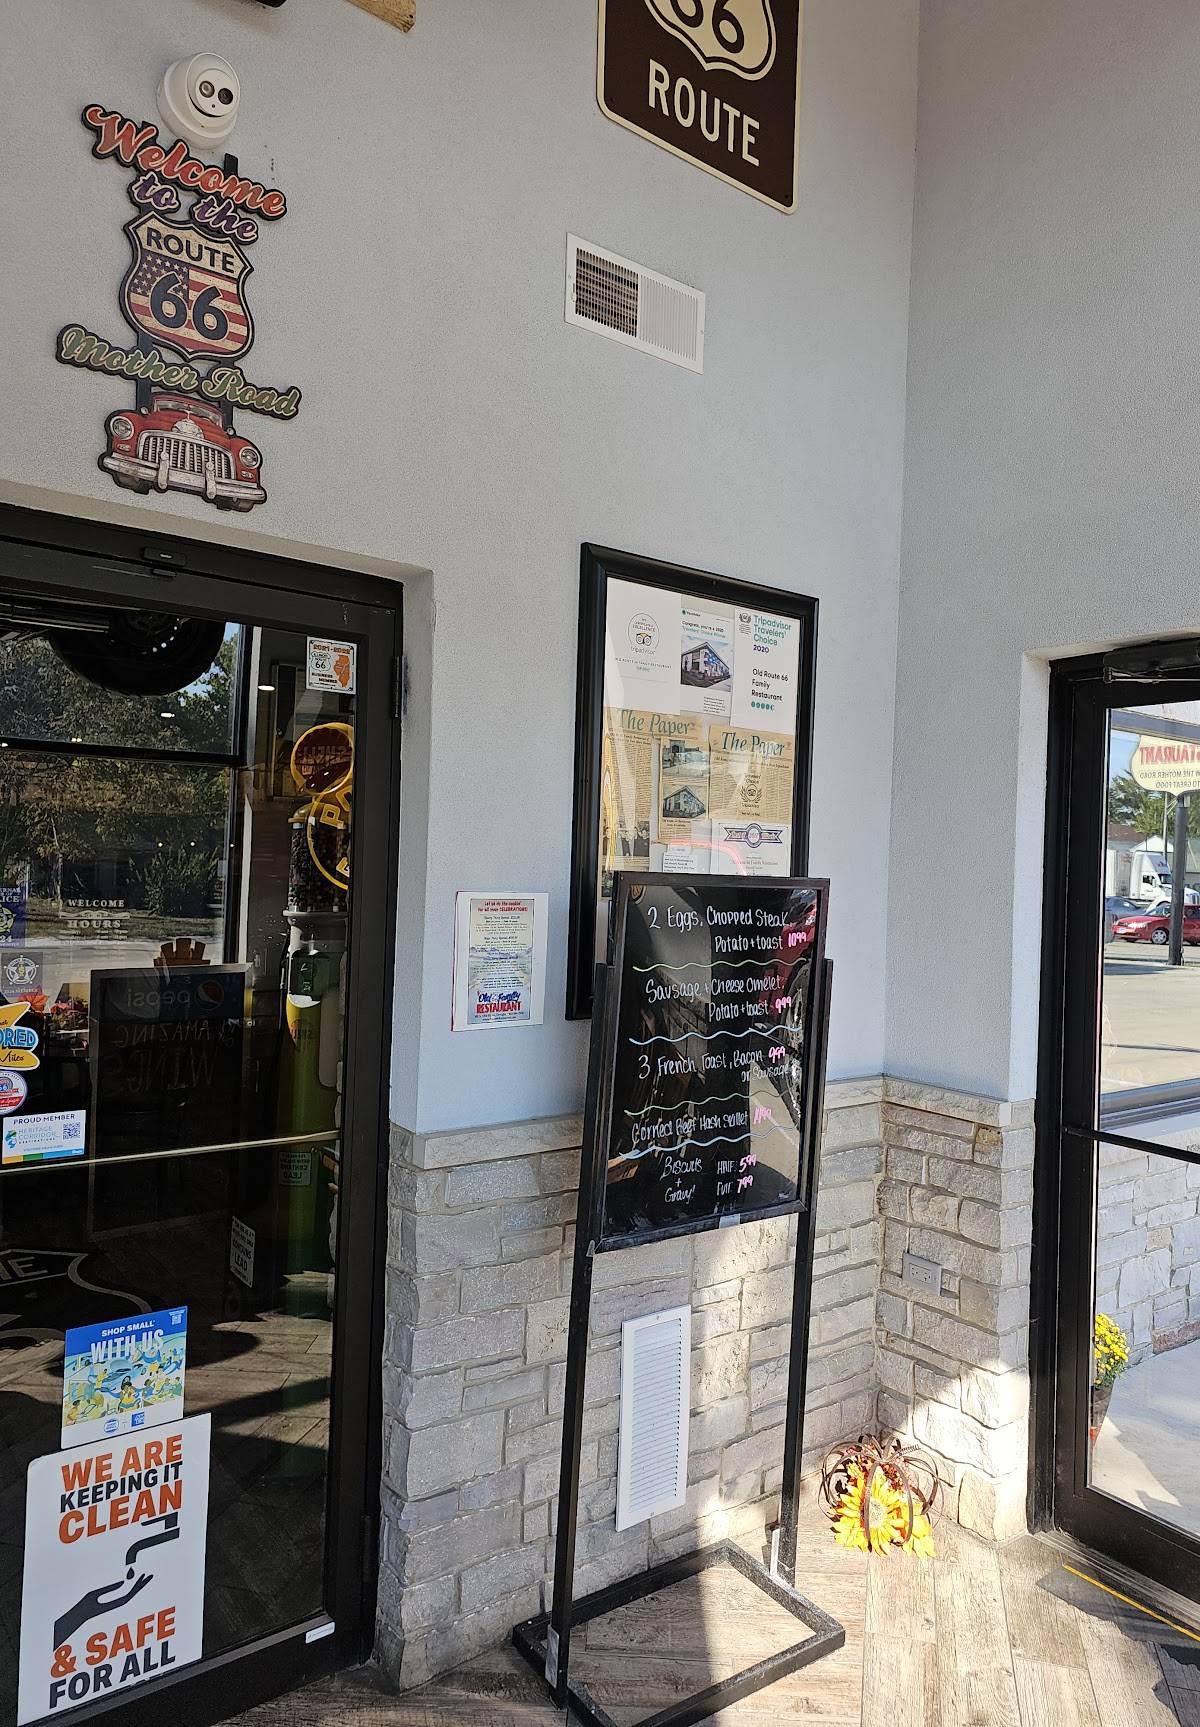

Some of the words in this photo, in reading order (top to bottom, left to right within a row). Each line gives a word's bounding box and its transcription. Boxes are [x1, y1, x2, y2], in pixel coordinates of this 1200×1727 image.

[648, 58, 760, 167] ROUTE
[86, 106, 285, 216] Welcome
[131, 172, 179, 210] to
[193, 195, 258, 242] the
[146, 226, 235, 274] ROUTE
[150, 271, 229, 341] 66
[62, 327, 198, 390] Mother
[201, 367, 299, 417] Road
[753, 614, 792, 631] Tripadvisor
[753, 633, 778, 646] Choice
[753, 644, 770, 654] 2020
[315, 661, 326, 670] 66
[752, 668, 763, 677] Old
[763, 671, 780, 681] Route
[781, 673, 789, 681] 66
[751, 689, 783, 701] Restaurant
[752, 678, 770, 690] Family
[620, 709, 645, 731] The
[650, 713, 691, 737] Paper
[722, 731, 747, 752] The
[751, 734, 786, 759] Paper
[67, 899, 125, 908] WELCOME
[67, 919, 121, 929] HOURS
[648, 906, 661, 929] 2
[706, 905, 752, 927] Chopped
[714, 935, 748, 953] Potato
[756, 935, 783, 950] toast
[478, 992, 492, 1003] Old
[646, 979, 701, 1004] Sausage
[711, 978, 745, 996] Cheese
[476, 1002, 522, 1014] RESTAURANT
[708, 1002, 739, 1023] Potato
[638, 1054, 651, 1079] 3
[657, 1055, 697, 1077] French
[734, 1050, 763, 1068] Bacon
[752, 1062, 790, 1081] Sausage
[13, 1116, 42, 1125] PROUD
[43, 1113, 75, 1122] MEMBER
[676, 1117, 698, 1137] Beef
[699, 1113, 721, 1131] Hash
[234, 1252, 248, 1271] LEAD
[101, 1325, 126, 1337] SHOP
[126, 1320, 155, 1332] SMALL
[90, 1336, 136, 1365] WITH
[141, 1328, 164, 1352] US
[61, 1452, 113, 1492] WE
[119, 1434, 184, 1477] ARE
[60, 1469, 158, 1513] KEEPING
[163, 1460, 184, 1483] IT
[58, 1479, 183, 1545] CLEAN
[50, 1643, 77, 1679] &
[85, 1606, 177, 1667] SAFE
[49, 1663, 113, 1709] FOR
[119, 1639, 177, 1683] ALL
